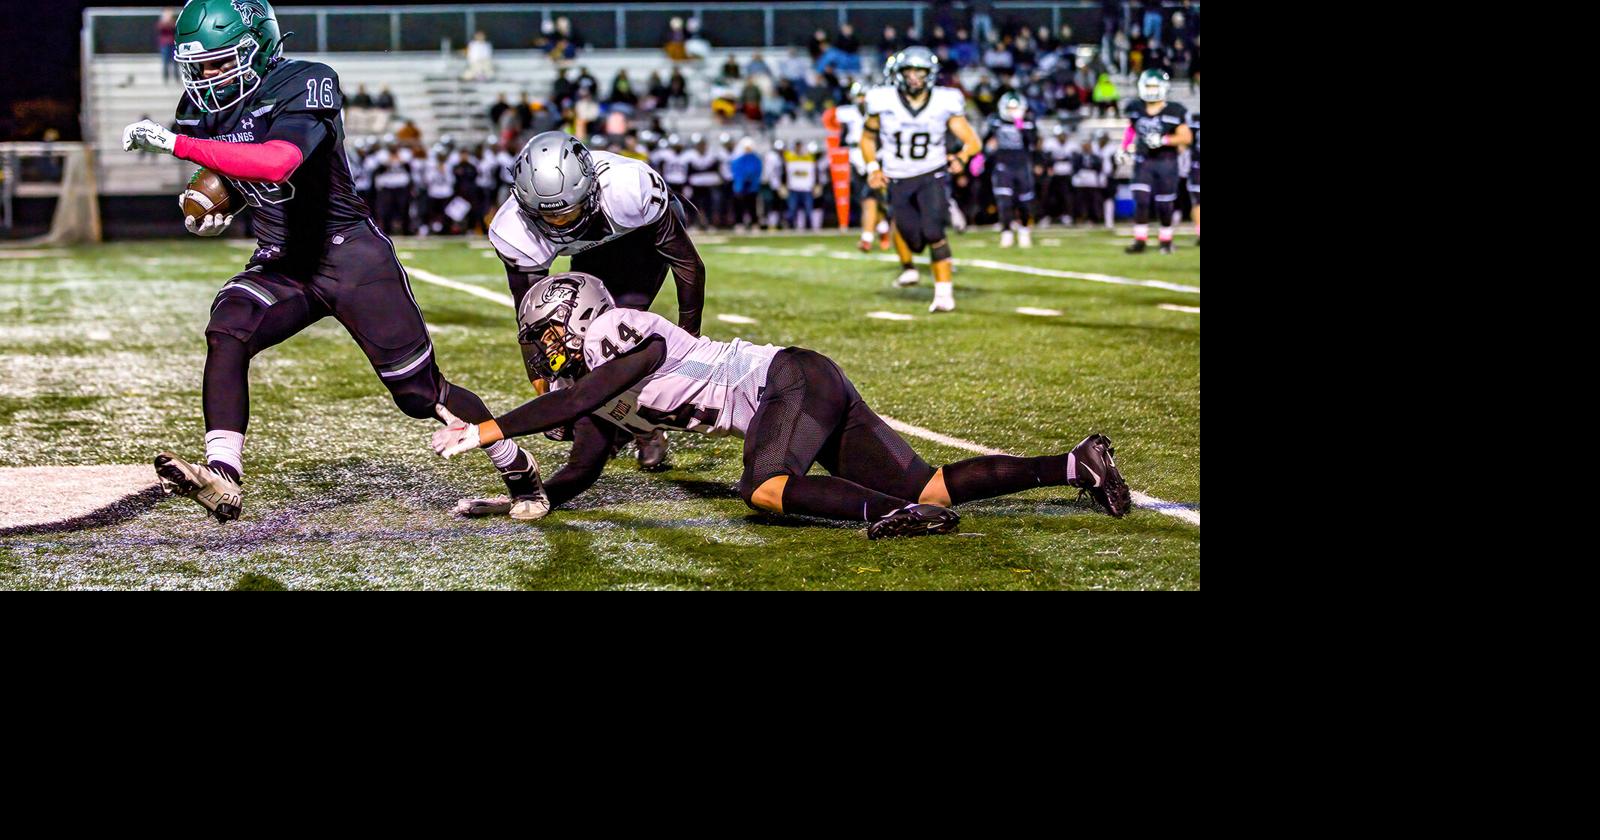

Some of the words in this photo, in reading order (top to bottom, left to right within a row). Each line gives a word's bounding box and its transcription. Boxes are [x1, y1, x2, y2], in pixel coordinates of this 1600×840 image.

[305, 77, 334, 108] 16
[893, 131, 930, 160] 18
[647, 171, 666, 209] 15
[599, 321, 644, 360] 44
